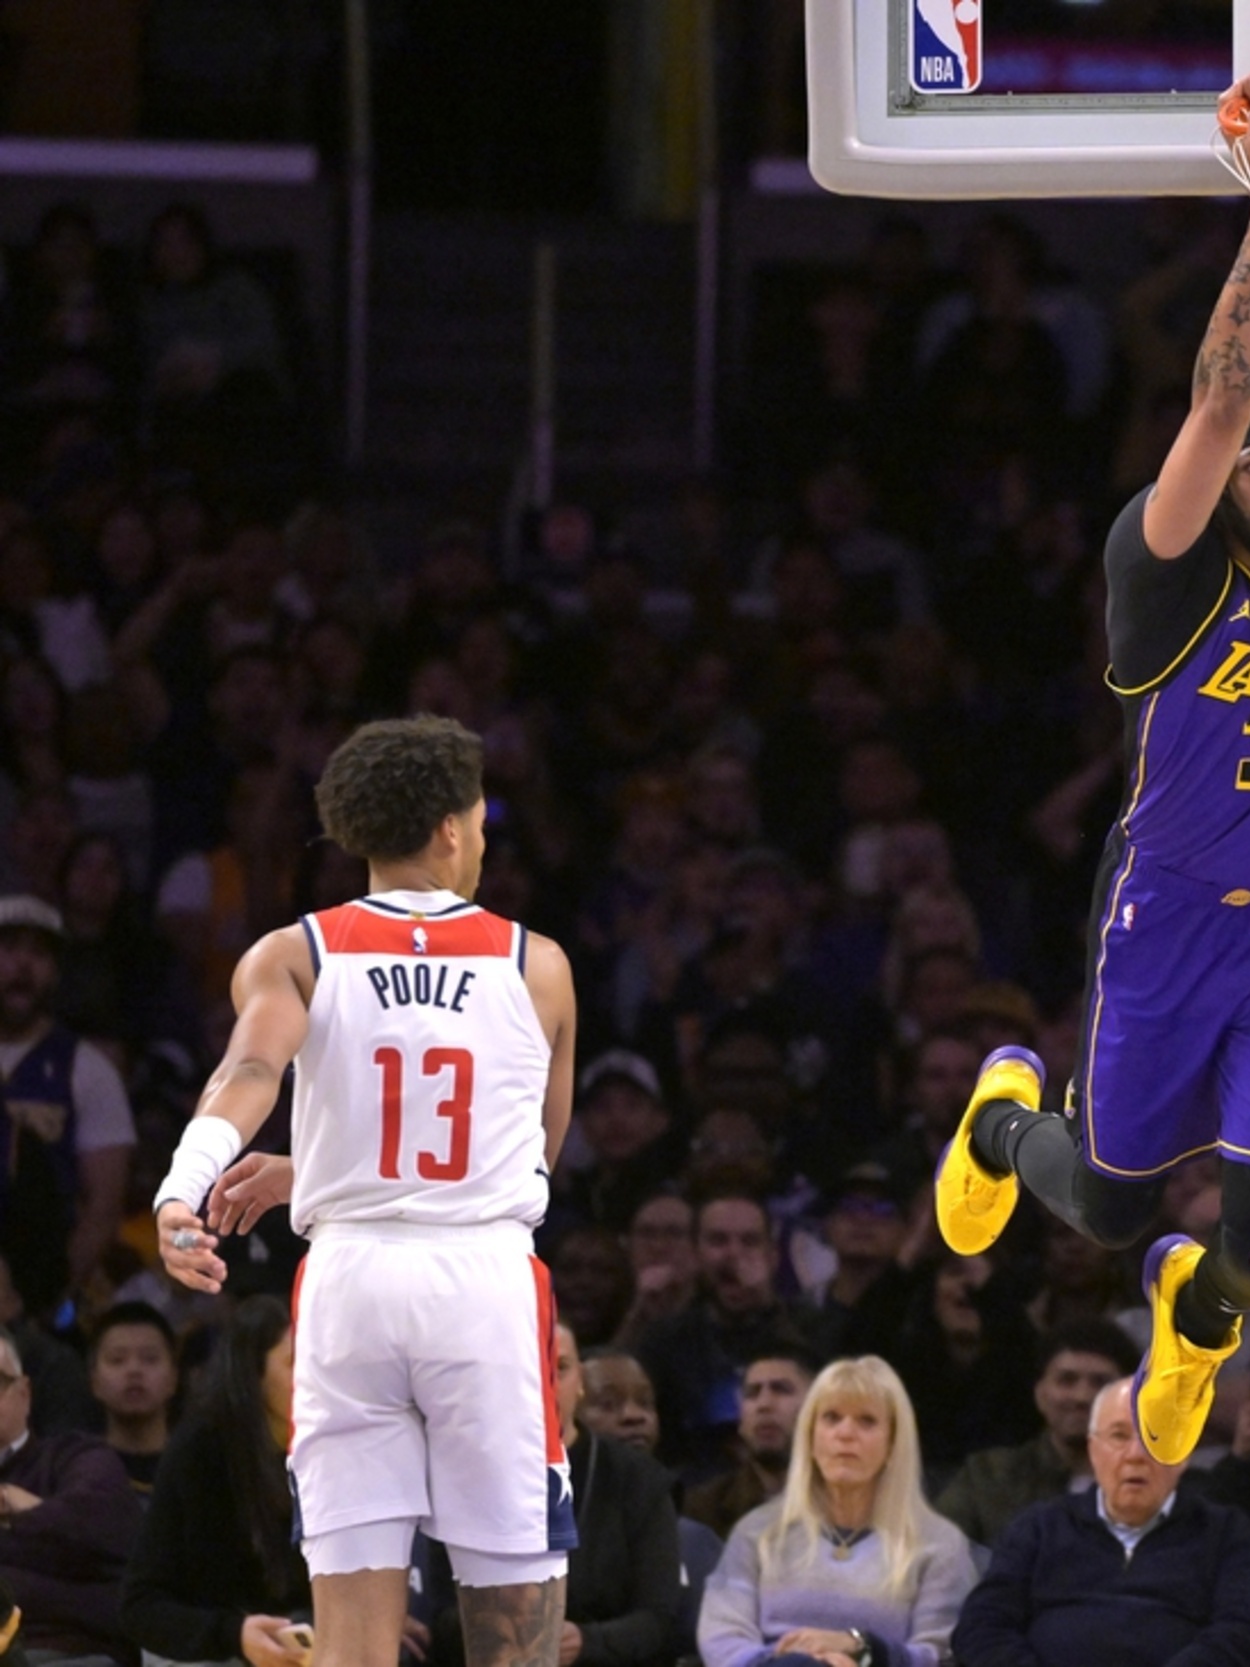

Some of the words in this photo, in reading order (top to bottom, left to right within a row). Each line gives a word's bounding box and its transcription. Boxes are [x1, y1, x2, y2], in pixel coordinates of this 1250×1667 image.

[921, 56, 954, 82] NBA
[367, 964, 476, 1013] POOLE
[374, 1046, 474, 1181] 13
